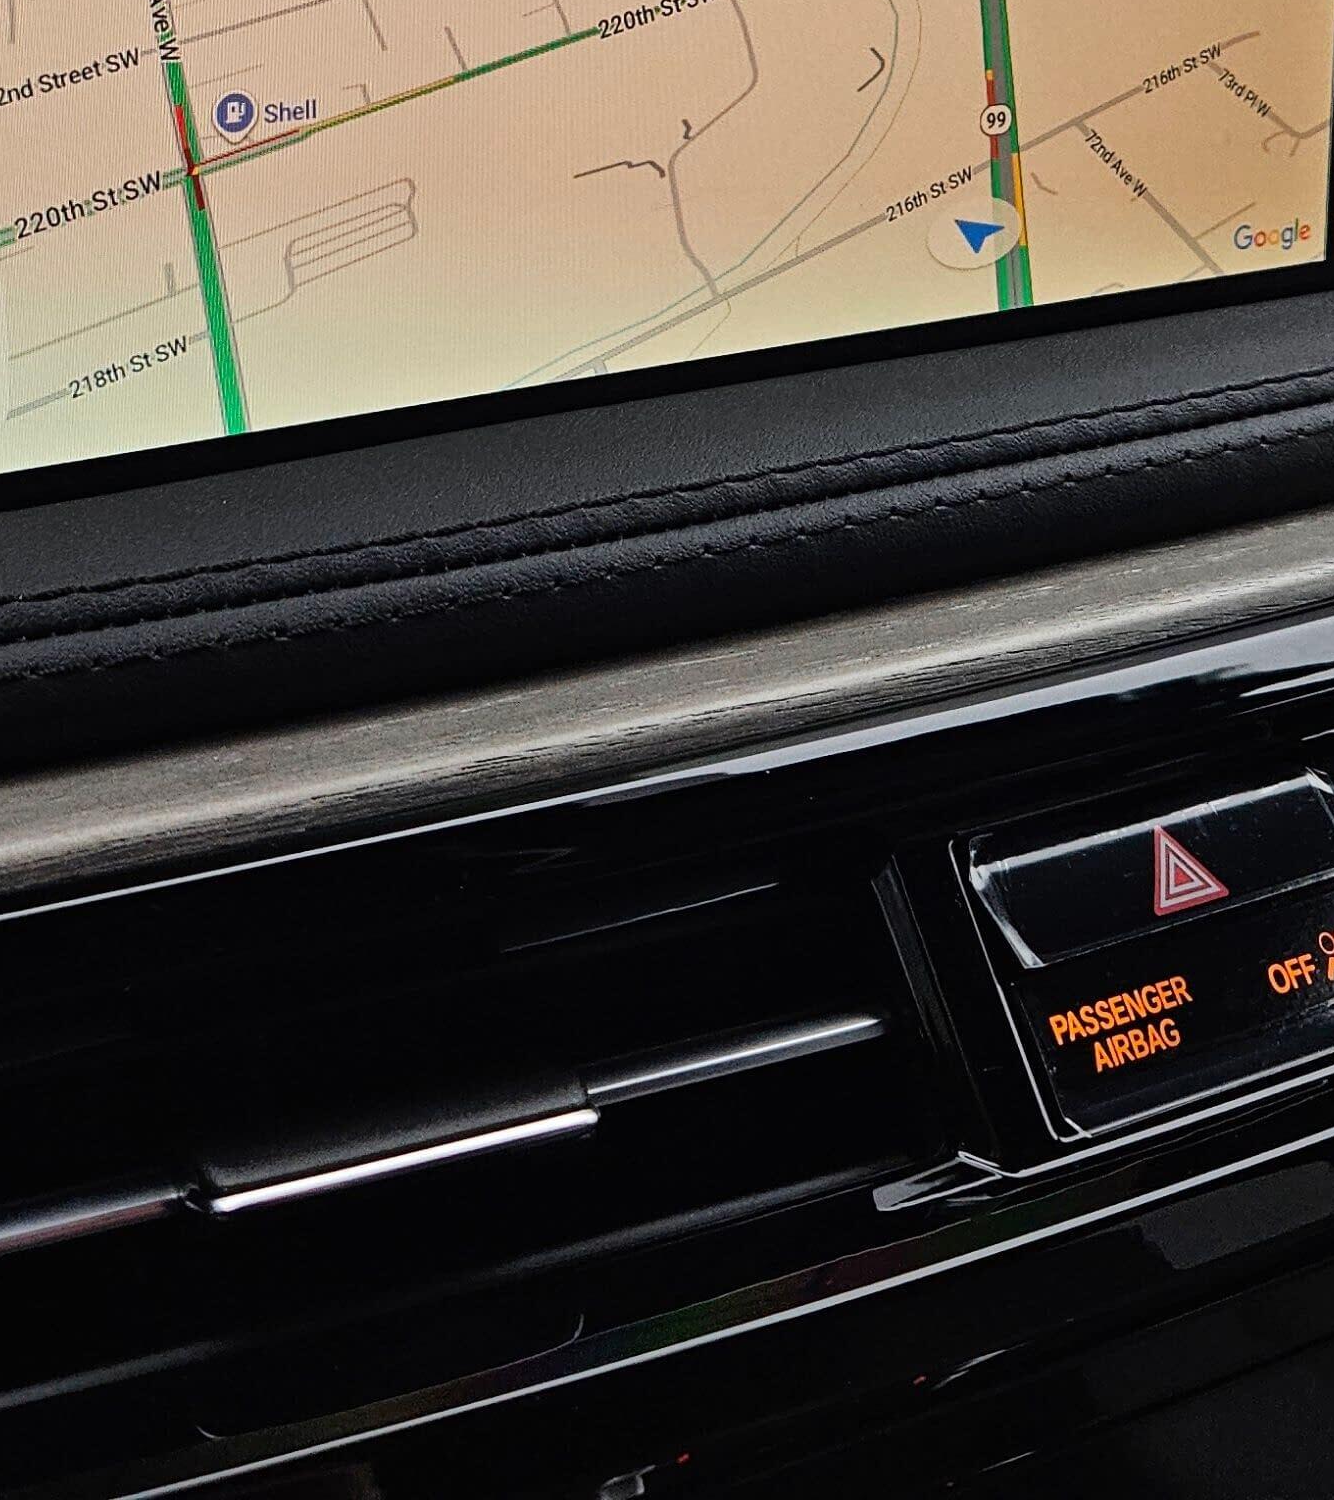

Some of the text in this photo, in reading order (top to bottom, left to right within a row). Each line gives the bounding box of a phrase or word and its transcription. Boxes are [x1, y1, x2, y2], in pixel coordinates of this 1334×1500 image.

[598, 5, 655, 40] 220th
[39, 61, 103, 94] Street
[106, 47, 142, 75] SW
[158, 38, 181, 62] W
[1143, 44, 1223, 94] 216th St SW
[263, 99, 318, 124] Shell
[1219, 69, 1272, 118] 73rd Pl W
[986, 112, 1007, 129] 99
[1085, 130, 1149, 199] 72nd Ave W
[14, 171, 163, 239] 220th St SW
[885, 166, 975, 223] 216th St SW
[1232, 217, 1312, 251] Google
[69, 336, 189, 399] 218th St SW
[1268, 953, 1317, 994] OFF
[1049, 975, 1194, 1046] PASSENGER
[1093, 1019, 1181, 1073] AIRBAG
